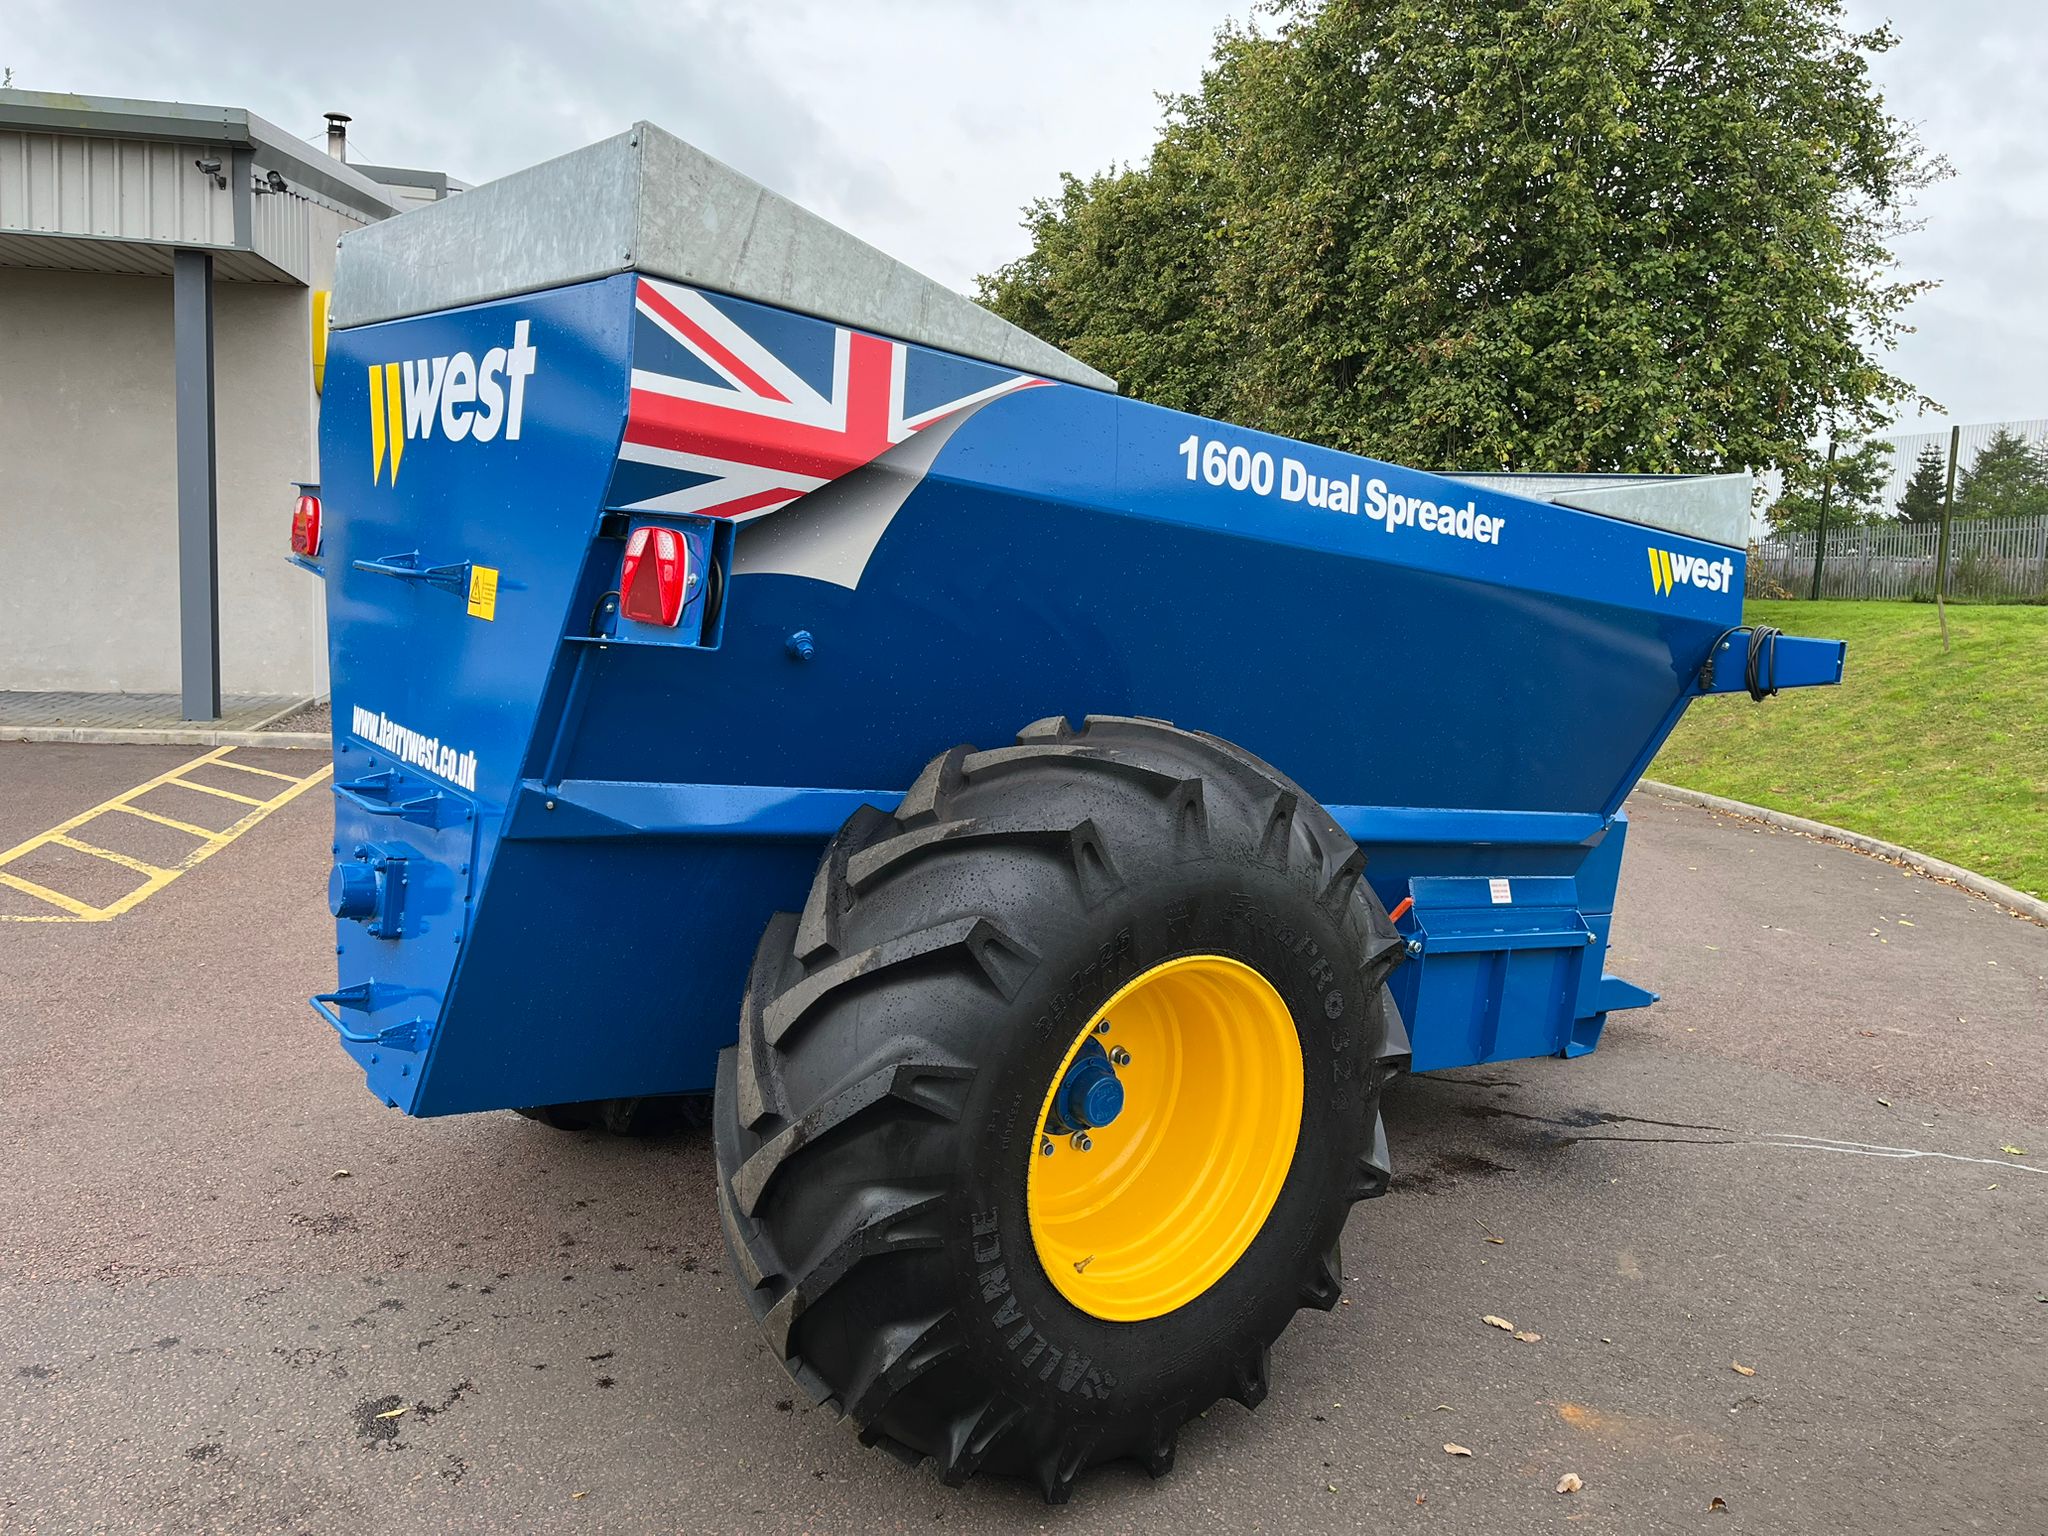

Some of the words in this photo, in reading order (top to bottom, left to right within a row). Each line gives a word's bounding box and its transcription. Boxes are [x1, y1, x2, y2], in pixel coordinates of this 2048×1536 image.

[403, 320, 536, 442] west
[1179, 435, 1274, 496] 1600
[1281, 458, 1360, 514] Dual
[1365, 479, 1505, 545] Spreader
[1670, 552, 1733, 593] west
[352, 703, 477, 792] www.harrywest.co.uk
[971, 1206, 1093, 1393] ALLIANCE
